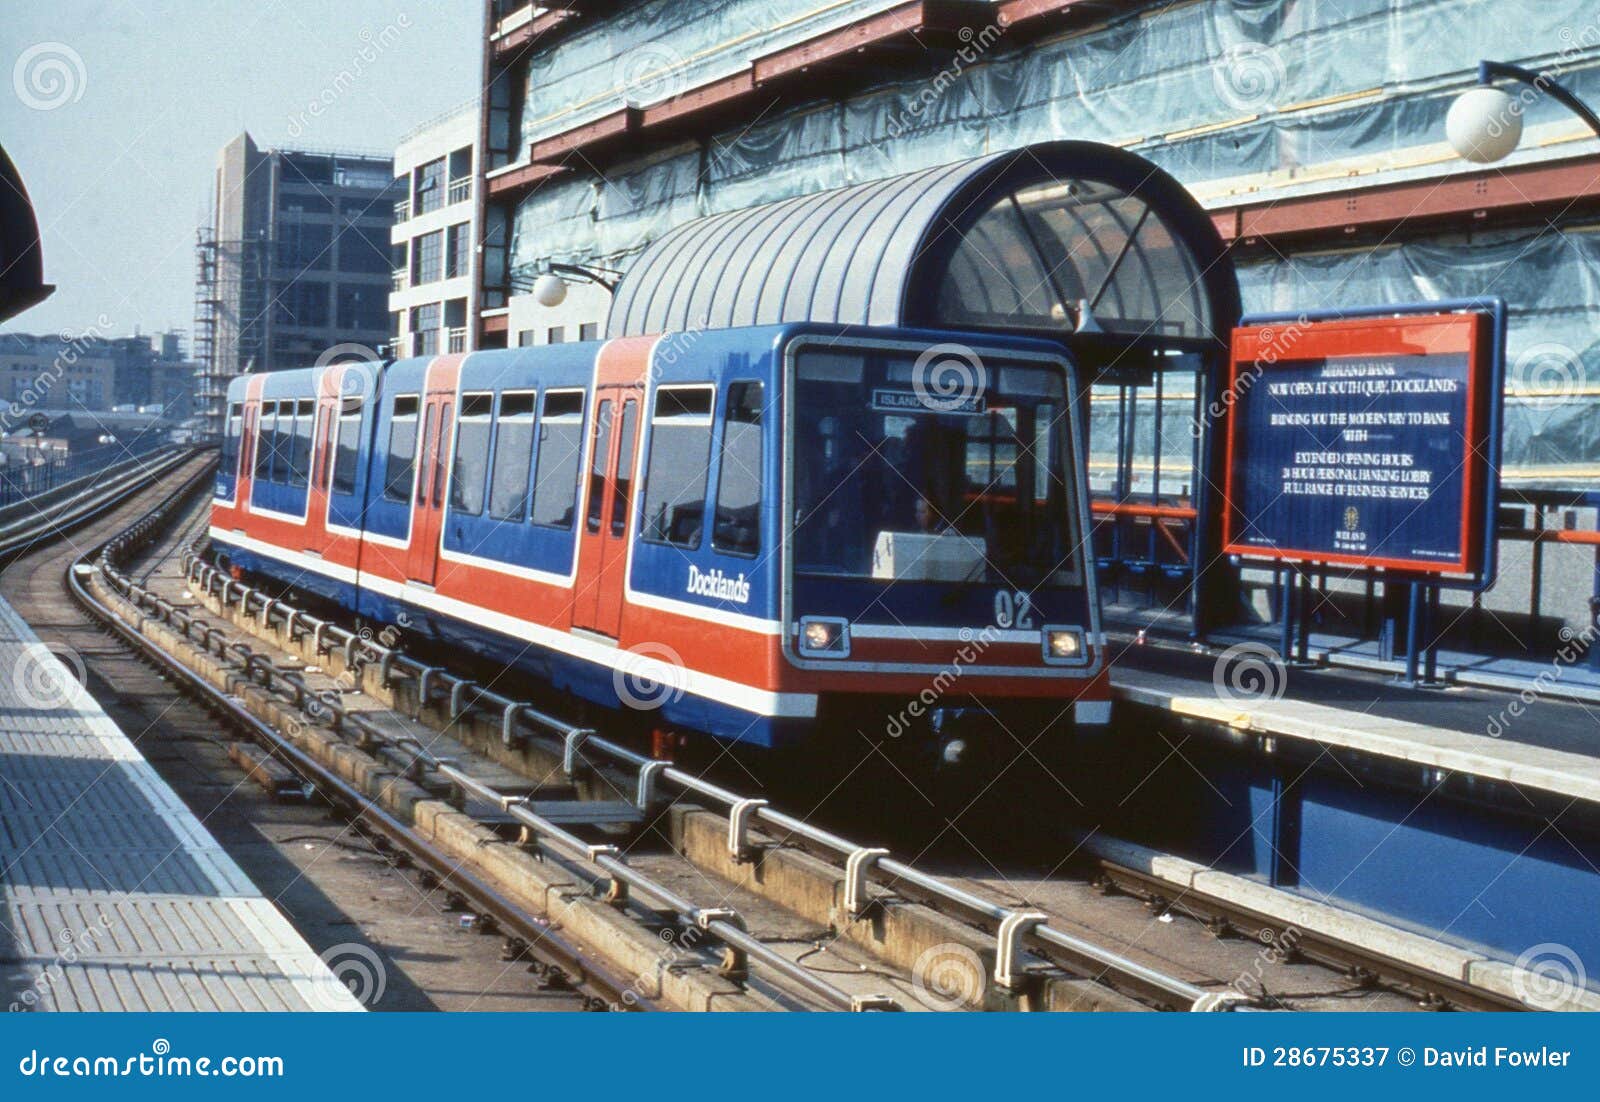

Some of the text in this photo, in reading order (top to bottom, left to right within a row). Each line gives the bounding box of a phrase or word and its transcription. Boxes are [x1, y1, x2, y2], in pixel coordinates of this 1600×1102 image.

[1367, 362, 1396, 376] BANK
[1269, 382, 1289, 395] NOW
[1290, 381, 1314, 395] OPEN
[1315, 381, 1327, 394] AT
[1328, 380, 1361, 394] SOUTH
[1391, 378, 1457, 393] DOCKLANDS
[1271, 411, 1450, 425] BRINGING YOU THE MODERN WAY TO BANK
[1295, 451, 1414, 466] EXTENDED OPENING HOURS
[1291, 467, 1316, 480] HOUR
[1317, 467, 1358, 481] PERSONAL
[1359, 468, 1400, 482] BANKING
[1401, 470, 1432, 483] LOBBY
[1283, 481, 1429, 499] FULL RANGE OF BUSINESS SERVICES
[686, 564, 751, 604] Docklands
[995, 590, 1033, 629] 02
